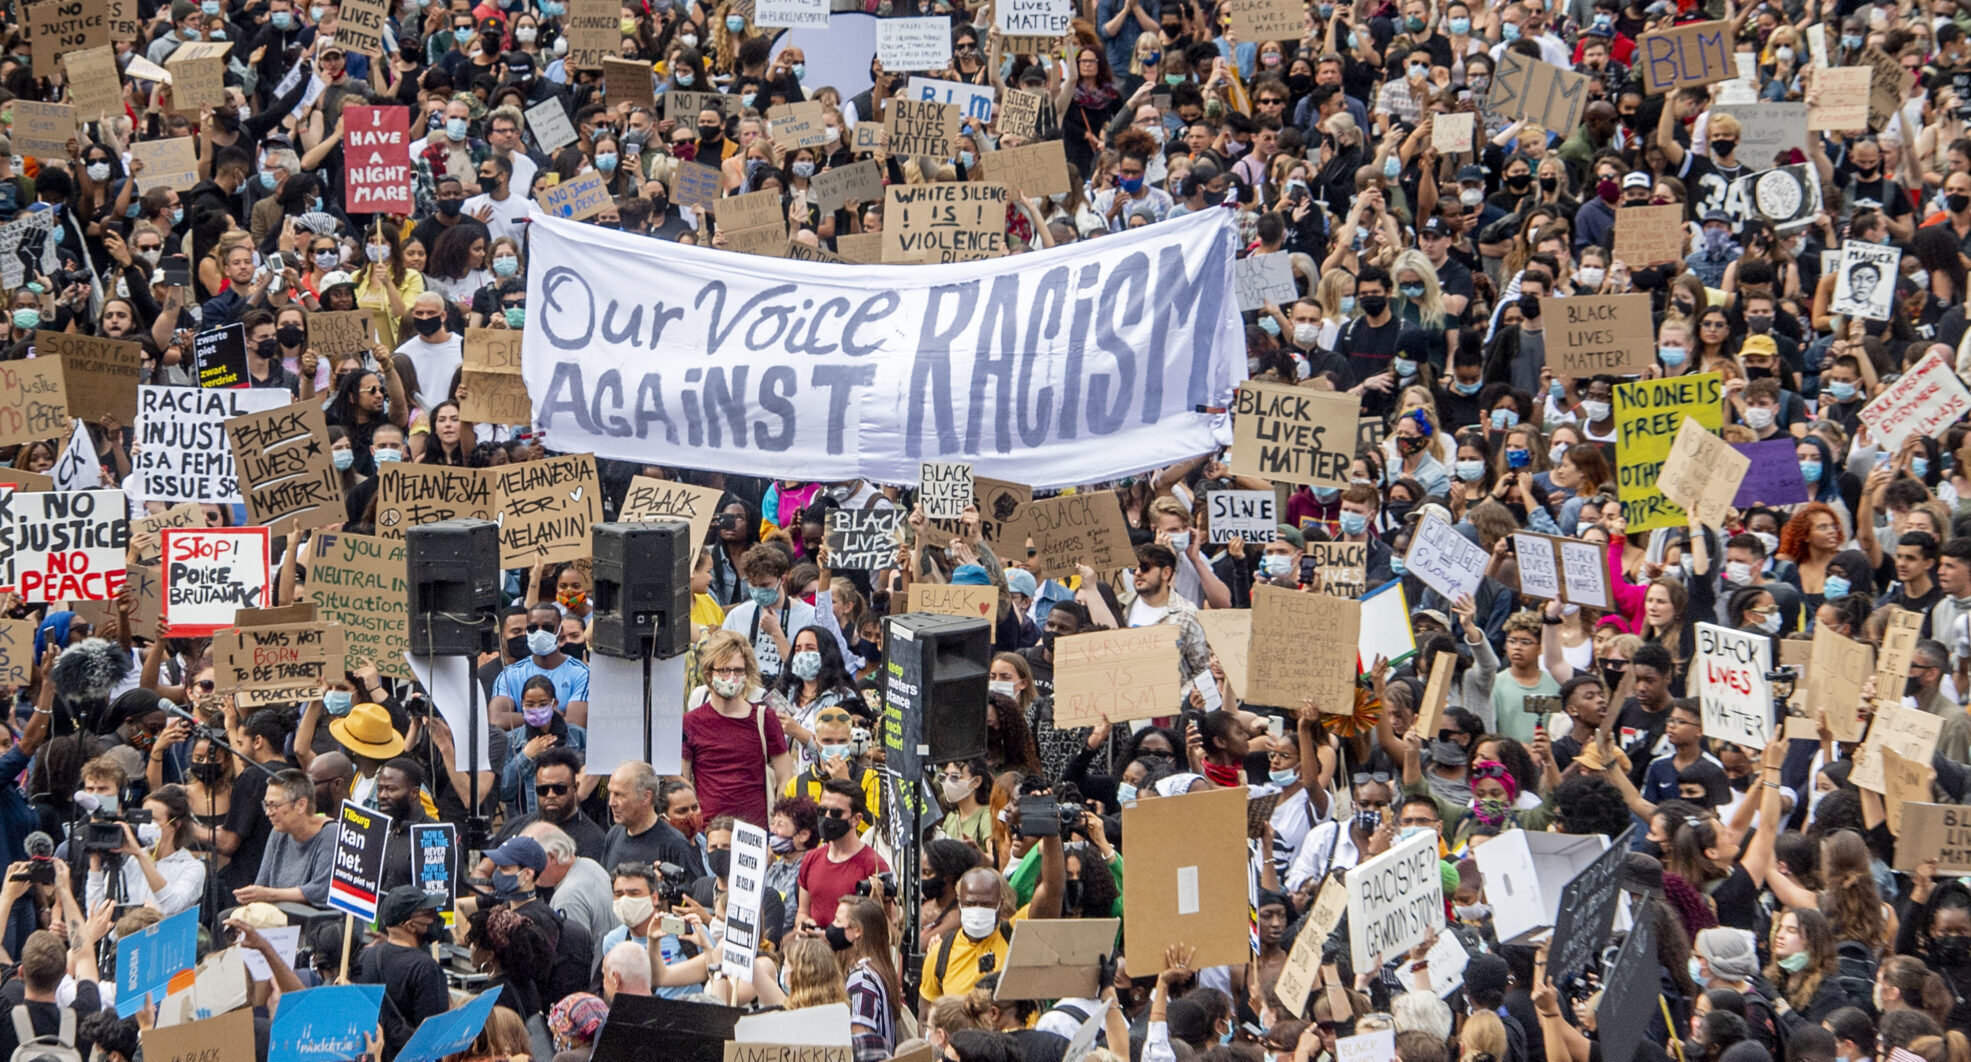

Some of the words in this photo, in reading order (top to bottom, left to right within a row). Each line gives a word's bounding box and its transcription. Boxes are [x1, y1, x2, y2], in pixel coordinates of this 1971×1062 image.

[57, 2, 82, 17] NO
[1012, 0, 1052, 12] LIVES
[1231, 0, 1273, 11] BLACK
[41, 17, 102, 35] JUSTICE
[341, 6, 381, 30] LIVES
[571, 15, 619, 30] CHANGED
[1006, 13, 1070, 32] MATTER
[1247, 12, 1282, 25] LIVES
[1254, 21, 1303, 35] MATTER
[60, 33, 86, 47] NO
[336, 27, 380, 50] MATTER
[1001, 36, 1056, 54] ATTER
[1647, 30, 1729, 88] BLM
[673, 94, 693, 111] NO
[1006, 88, 1037, 108] SILENCE
[1488, 55, 1584, 134] BLM
[372, 110, 381, 126] I
[895, 103, 945, 122] BLACK
[1003, 105, 1039, 126] SUPPORTS
[785, 121, 811, 135] LIVES
[897, 122, 945, 141] LIVES
[1000, 120, 1035, 139] VIOLENCE
[350, 131, 402, 146] HAVE
[888, 138, 950, 157] MATTER
[369, 151, 384, 165] A
[350, 166, 408, 185] NIGHT
[354, 185, 409, 204] MARE
[547, 188, 569, 207] NO
[895, 186, 955, 204] WHITE
[959, 184, 1007, 203] SILENCE
[899, 230, 1004, 251] VIOLENCE
[541, 265, 686, 351] Our
[694, 279, 902, 357] Voice
[1566, 304, 1619, 324] BLACK
[45, 334, 109, 360] SORRY
[196, 330, 229, 346] zwarte
[1568, 330, 1615, 348] LIVES
[198, 345, 217, 362] piet
[199, 356, 208, 369] is
[1562, 349, 1632, 371] MATTER!
[200, 365, 227, 381] zwart
[201, 374, 238, 391] verdriet
[1617, 383, 1649, 410] NO
[1653, 382, 1694, 408] ONE
[1697, 379, 1719, 405] IS
[1238, 388, 1312, 422] BLACK
[231, 410, 309, 449] BLACK
[1255, 417, 1331, 456] LIVES
[1622, 411, 1680, 442] FREE
[155, 450, 171, 470] A
[1257, 449, 1353, 485] MATTER
[920, 463, 972, 483] BLACK
[921, 481, 969, 499] LIVES
[42, 490, 96, 521] NO
[628, 486, 703, 517] BLACK
[921, 497, 970, 518] MATTER
[146, 511, 194, 533] BLACK
[834, 510, 907, 540] BLACK
[1029, 497, 1099, 533] BLACK
[842, 531, 899, 553] LIVES
[1211, 526, 1277, 546] VIOLENCE
[171, 535, 239, 565] STOP!
[315, 533, 337, 556] IF
[343, 538, 385, 568] YOU
[827, 545, 901, 568] MATTER
[1313, 544, 1366, 567] BLACK
[1517, 539, 1548, 558] BLACK
[1564, 546, 1597, 564] BLACK
[46, 550, 91, 578] NO
[1520, 558, 1552, 576] LIVES
[1565, 562, 1598, 578] LIVES
[20, 569, 128, 603] PEACE
[312, 565, 388, 596] NEUTRAL
[1323, 567, 1363, 585] IVES
[920, 589, 978, 612] BLACK
[1270, 594, 1342, 618] FREEDOM
[1288, 616, 1338, 632] NEVER
[253, 631, 291, 650] WAS
[296, 629, 324, 648] NOT
[344, 628, 379, 648] have
[1700, 629, 1760, 665] BLACK
[254, 647, 300, 669] BORN
[251, 664, 274, 685] BE
[275, 661, 327, 683] TARGET
[1105, 668, 1135, 688] VS
[1706, 659, 1753, 696] LIVES
[250, 688, 322, 706] PRACTICE
[1072, 685, 1159, 718] RACISM
[343, 807, 370, 830] Tilburg
[339, 823, 366, 852] kan
[421, 838, 435, 849] THE
[435, 838, 449, 850] TIME
[336, 845, 364, 874] het.
[424, 847, 446, 858] NEVER
[424, 855, 446, 866] AGAIN
[421, 871, 434, 883] THE
[435, 871, 449, 883] TIME
[1360, 845, 1438, 914] RACISME?
[127, 946, 140, 992] BODEM
